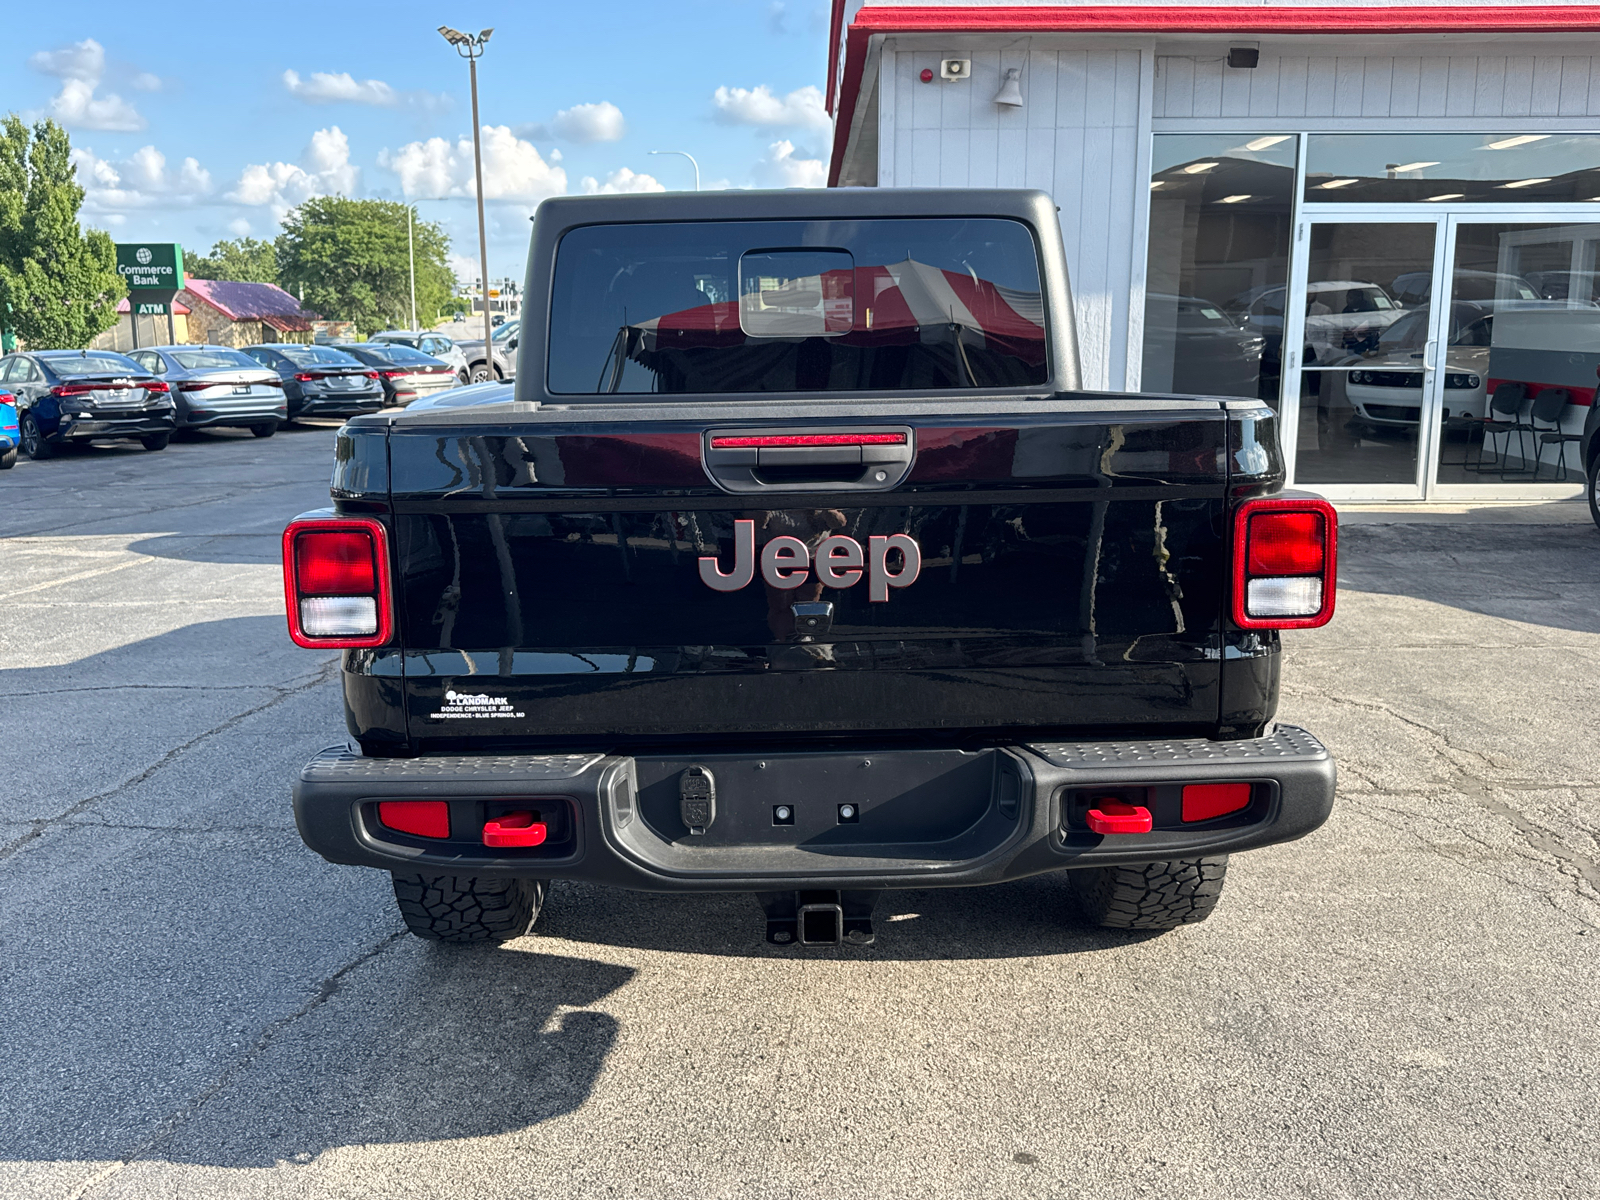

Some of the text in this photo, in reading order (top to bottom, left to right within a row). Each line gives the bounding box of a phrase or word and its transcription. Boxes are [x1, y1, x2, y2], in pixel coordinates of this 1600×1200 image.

[118, 264, 173, 274] Commerce
[133, 275, 159, 285] Bank
[139, 304, 164, 314] ATM
[698, 519, 922, 603] Jeep
[457, 697, 508, 705] LANDMARK
